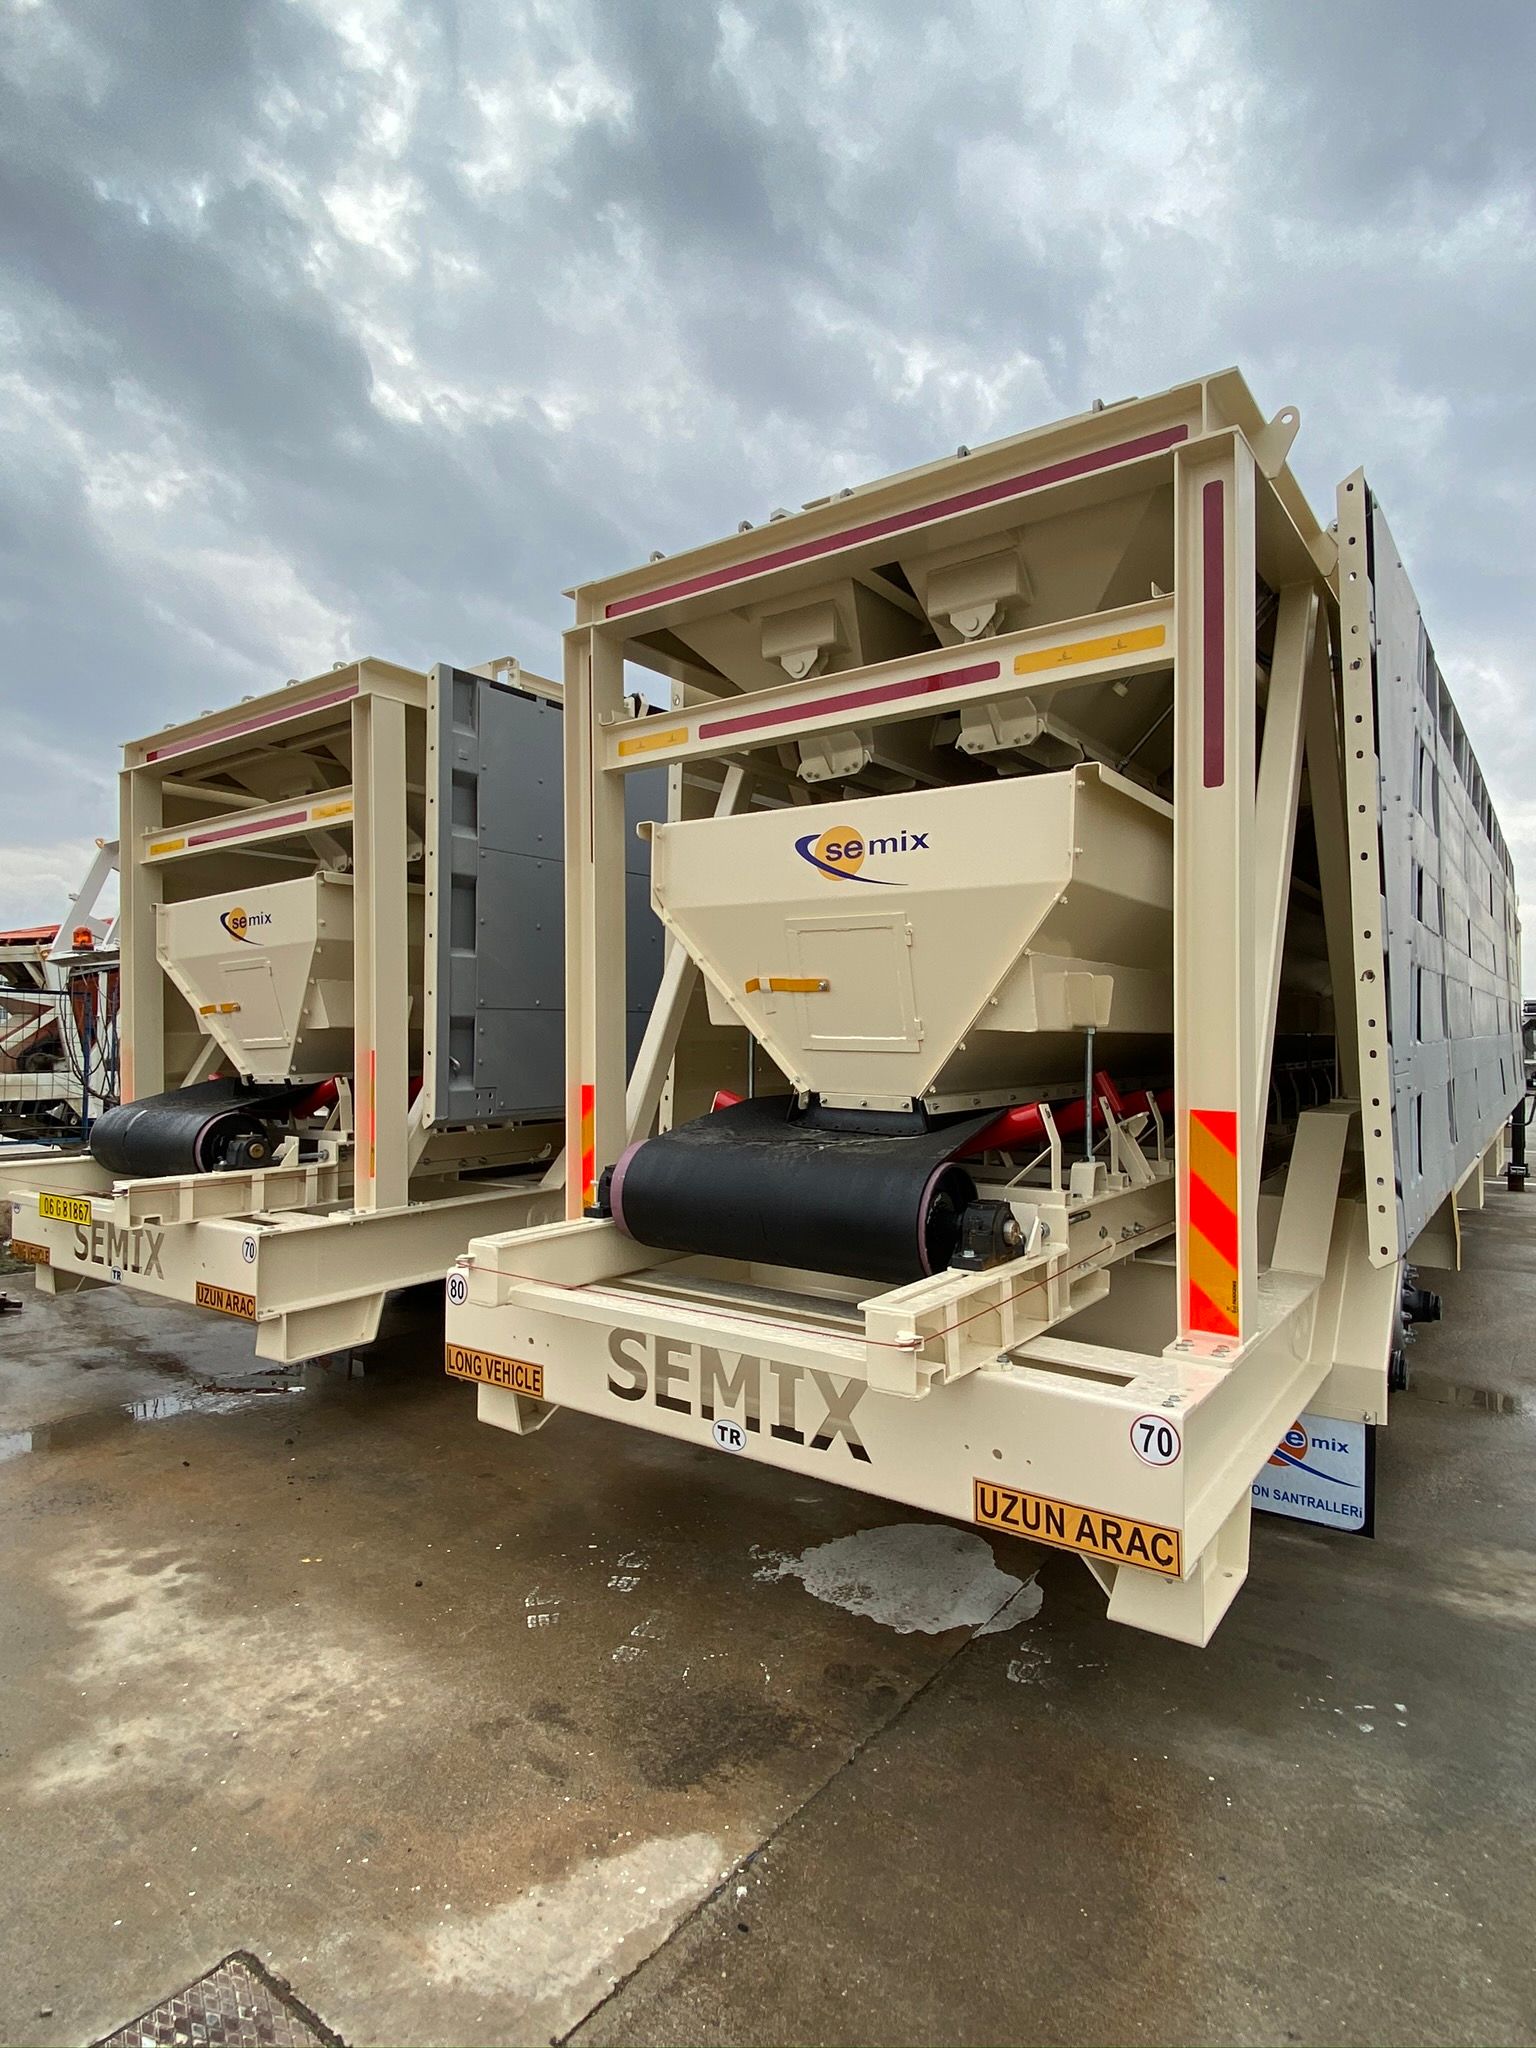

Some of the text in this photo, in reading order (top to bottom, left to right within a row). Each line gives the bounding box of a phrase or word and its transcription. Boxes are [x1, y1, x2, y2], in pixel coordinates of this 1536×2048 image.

[825, 830, 930, 862] semix
[231, 911, 272, 930] semix
[74, 1219, 164, 1280] SEMIX
[245, 1241, 255, 1259] 70
[112, 1269, 122, 1281] TR
[197, 1285, 224, 1309] UZUN
[450, 1279, 464, 1300] 80
[448, 1349, 541, 1393] LONG VEHICLE
[607, 1326, 872, 1464] SEMIX
[717, 1425, 742, 1446] TR
[1138, 1423, 1173, 1458] 70
[1285, 1430, 1350, 1454] emix
[1251, 1484, 1270, 1498] ON
[979, 1486, 1066, 1539] UZUN
